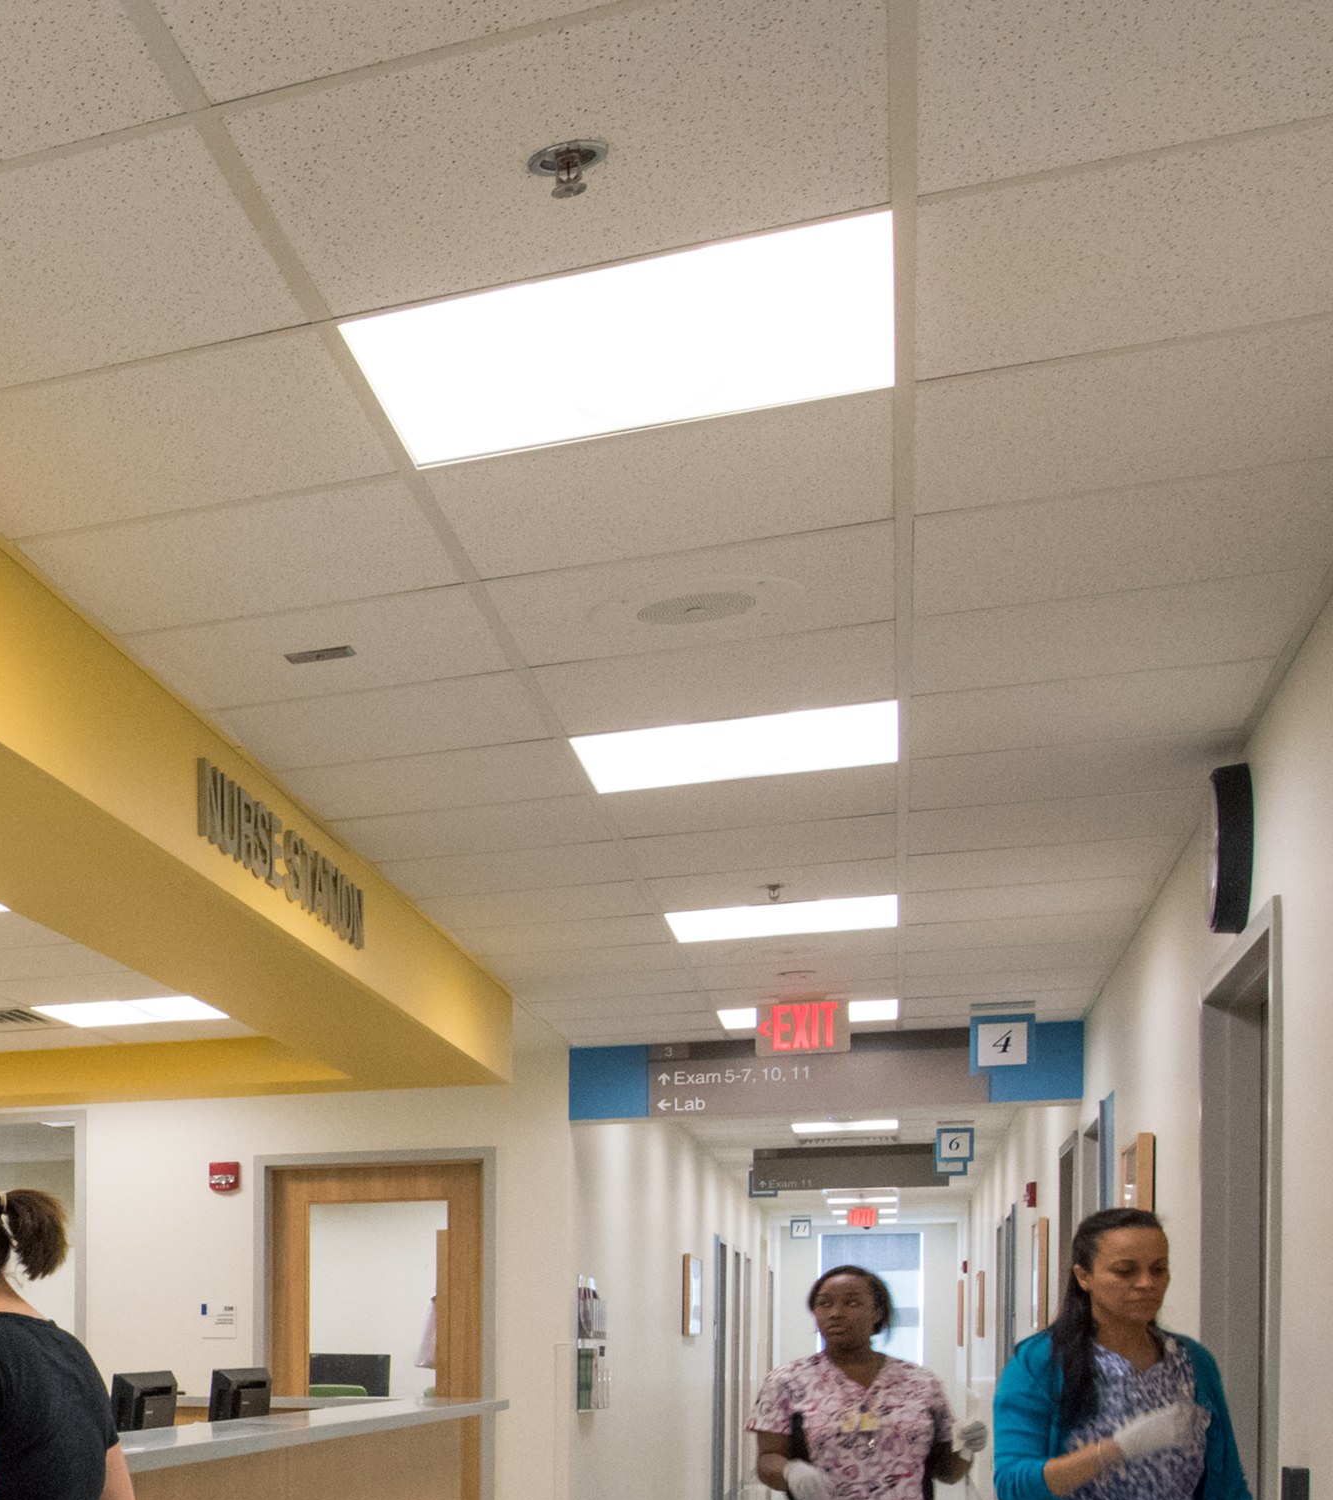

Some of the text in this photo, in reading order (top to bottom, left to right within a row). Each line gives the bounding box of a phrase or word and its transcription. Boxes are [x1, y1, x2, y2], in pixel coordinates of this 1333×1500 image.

[196, 757, 364, 950] NURSE STATION
[772, 1002, 838, 1050] EXIT
[992, 1029, 1012, 1053] 4
[664, 1046, 673, 1057] 3
[674, 1066, 809, 1085] Exam 5-7, 10, 11
[674, 1097, 706, 1111] Lab
[948, 1136, 961, 1151] 6
[768, 1179, 812, 1188] Exam 11
[851, 1208, 876, 1227] EXIT
[795, 1224, 807, 1233] 11
